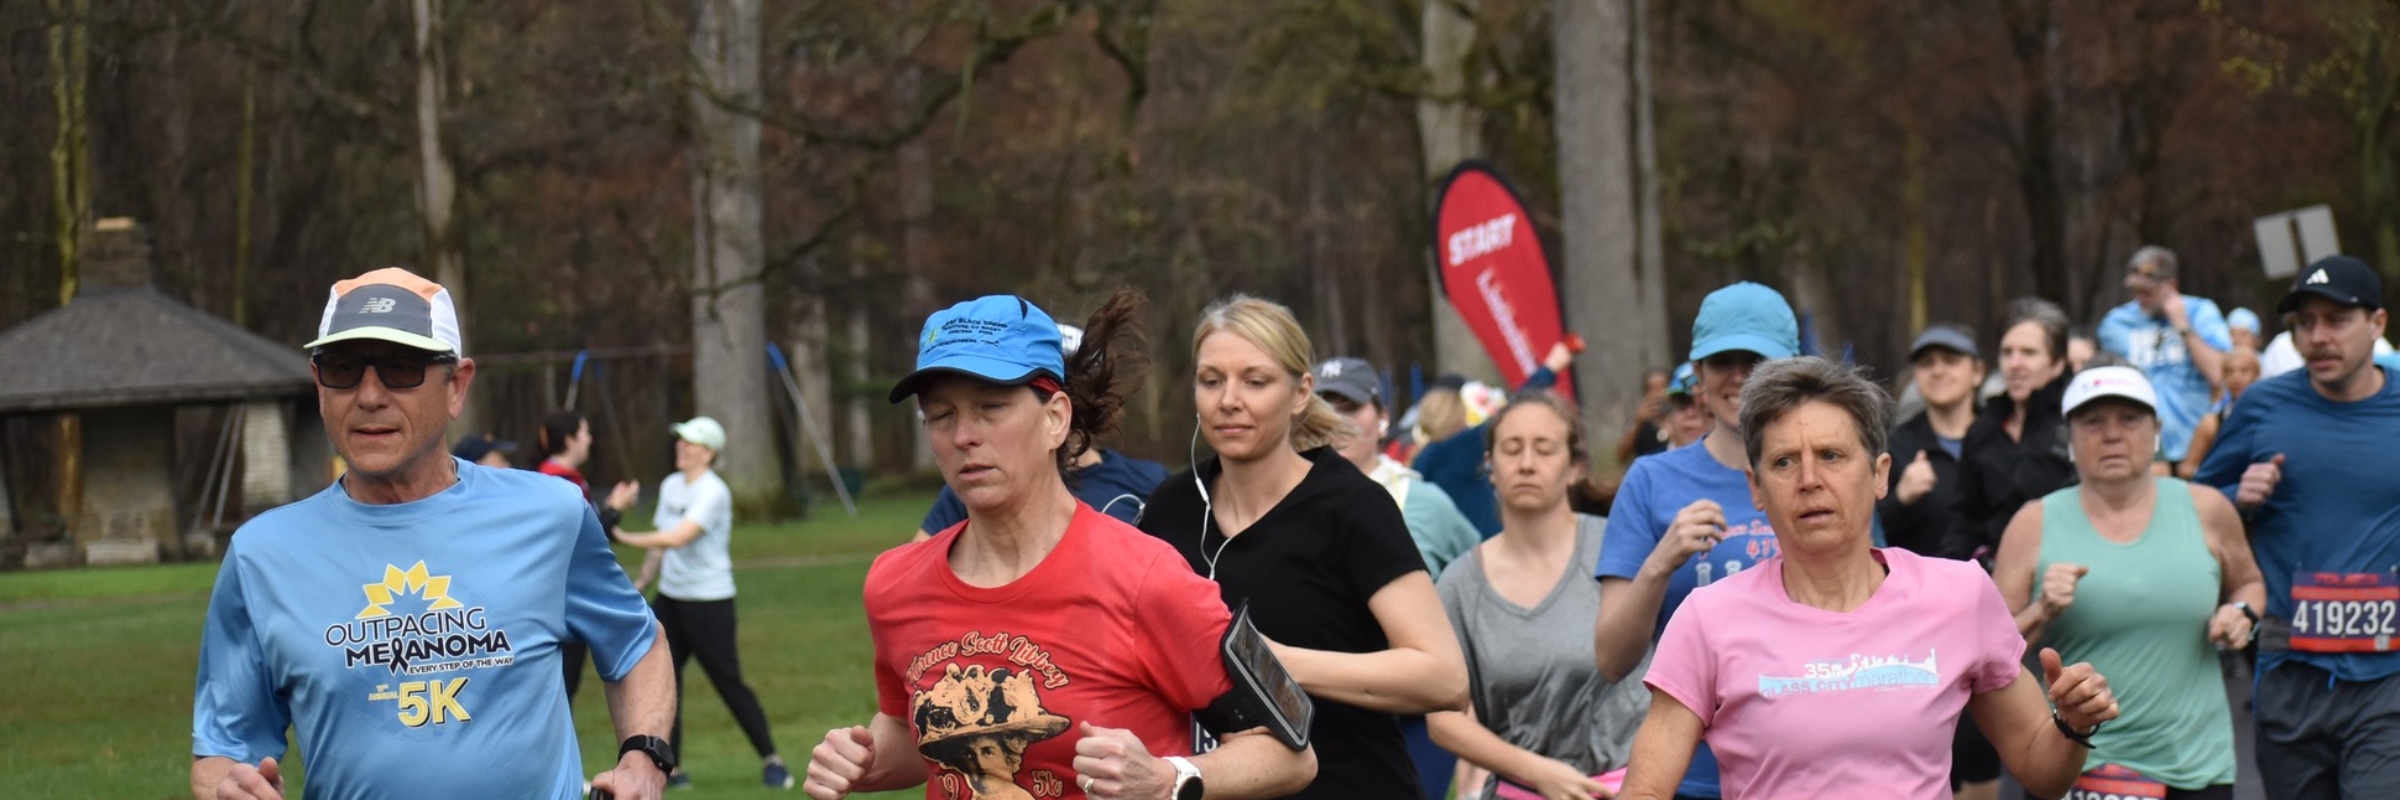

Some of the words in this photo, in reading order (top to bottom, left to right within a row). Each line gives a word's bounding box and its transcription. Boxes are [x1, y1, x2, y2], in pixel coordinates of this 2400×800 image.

[1448, 212, 1517, 267] START
[325, 608, 486, 647] OUTPACING
[2292, 600, 2396, 636] 419232
[409, 663, 438, 675] EVERY
[439, 661, 461, 672] STEP
[462, 660, 475, 669] OF
[476, 658, 492, 668] THE
[494, 656, 515, 666] WAY
[961, 631, 1010, 657] Scott
[1008, 636, 1070, 689] Libbey
[398, 677, 472, 728] 5K
[1761, 680, 1812, 698] GLASS
[1856, 668, 1937, 687] marathon
